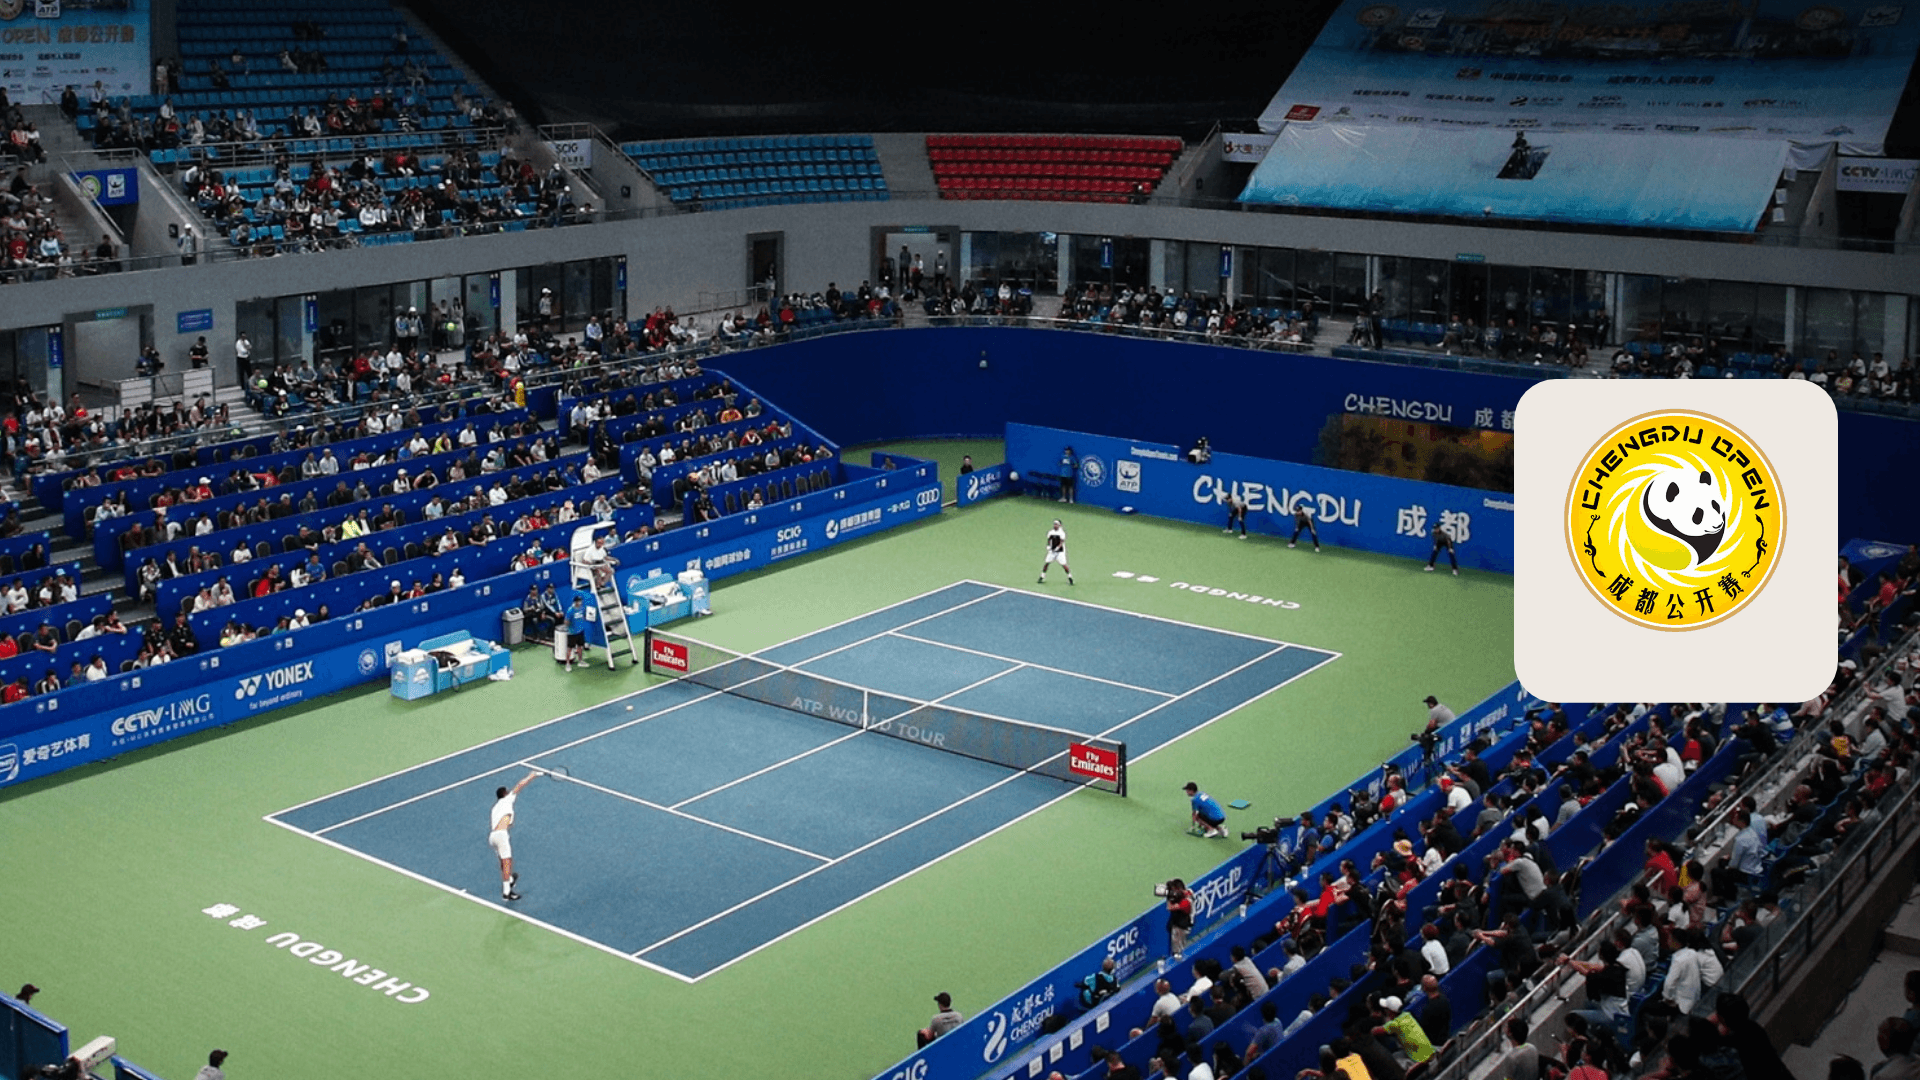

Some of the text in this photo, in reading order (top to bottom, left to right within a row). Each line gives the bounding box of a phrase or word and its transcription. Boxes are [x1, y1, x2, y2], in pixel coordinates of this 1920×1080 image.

[1344, 393, 1453, 423] CHENGDU
[1119, 480, 1138, 490] ATP
[1192, 475, 1362, 528] CHENGDU
[777, 525, 802, 543] SCIG
[1396, 504, 1471, 544] 成都
[1169, 581, 1301, 610] CHENGDU
[265, 660, 314, 691] YONEX
[790, 695, 947, 748] ATP WORLD TOUR
[23, 733, 91, 766] 爱奇艺体育
[1071, 756, 1115, 777] Emirates
[1107, 926, 1139, 958] SCIG
[265, 931, 431, 1004] CHENGDU
[1010, 1005, 1055, 1041] CHENGDU
